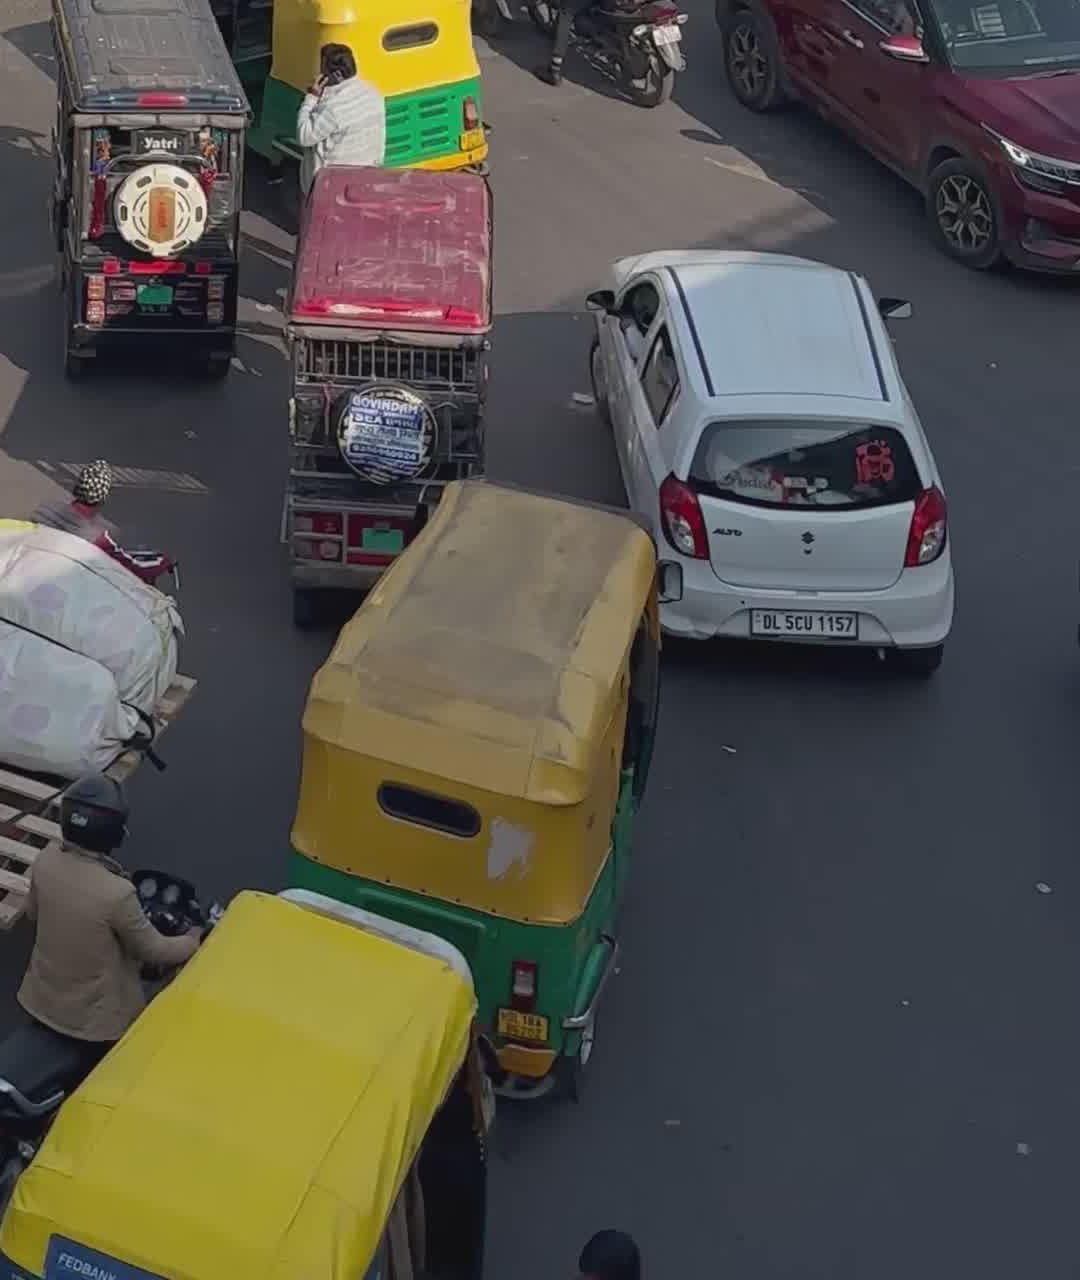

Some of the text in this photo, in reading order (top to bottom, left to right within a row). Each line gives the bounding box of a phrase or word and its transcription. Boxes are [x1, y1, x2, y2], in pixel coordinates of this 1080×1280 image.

[144, 137, 177, 149] Yatri
[712, 528, 743, 537] ALTO
[763, 614, 854, 632] DL 5CU 1157
